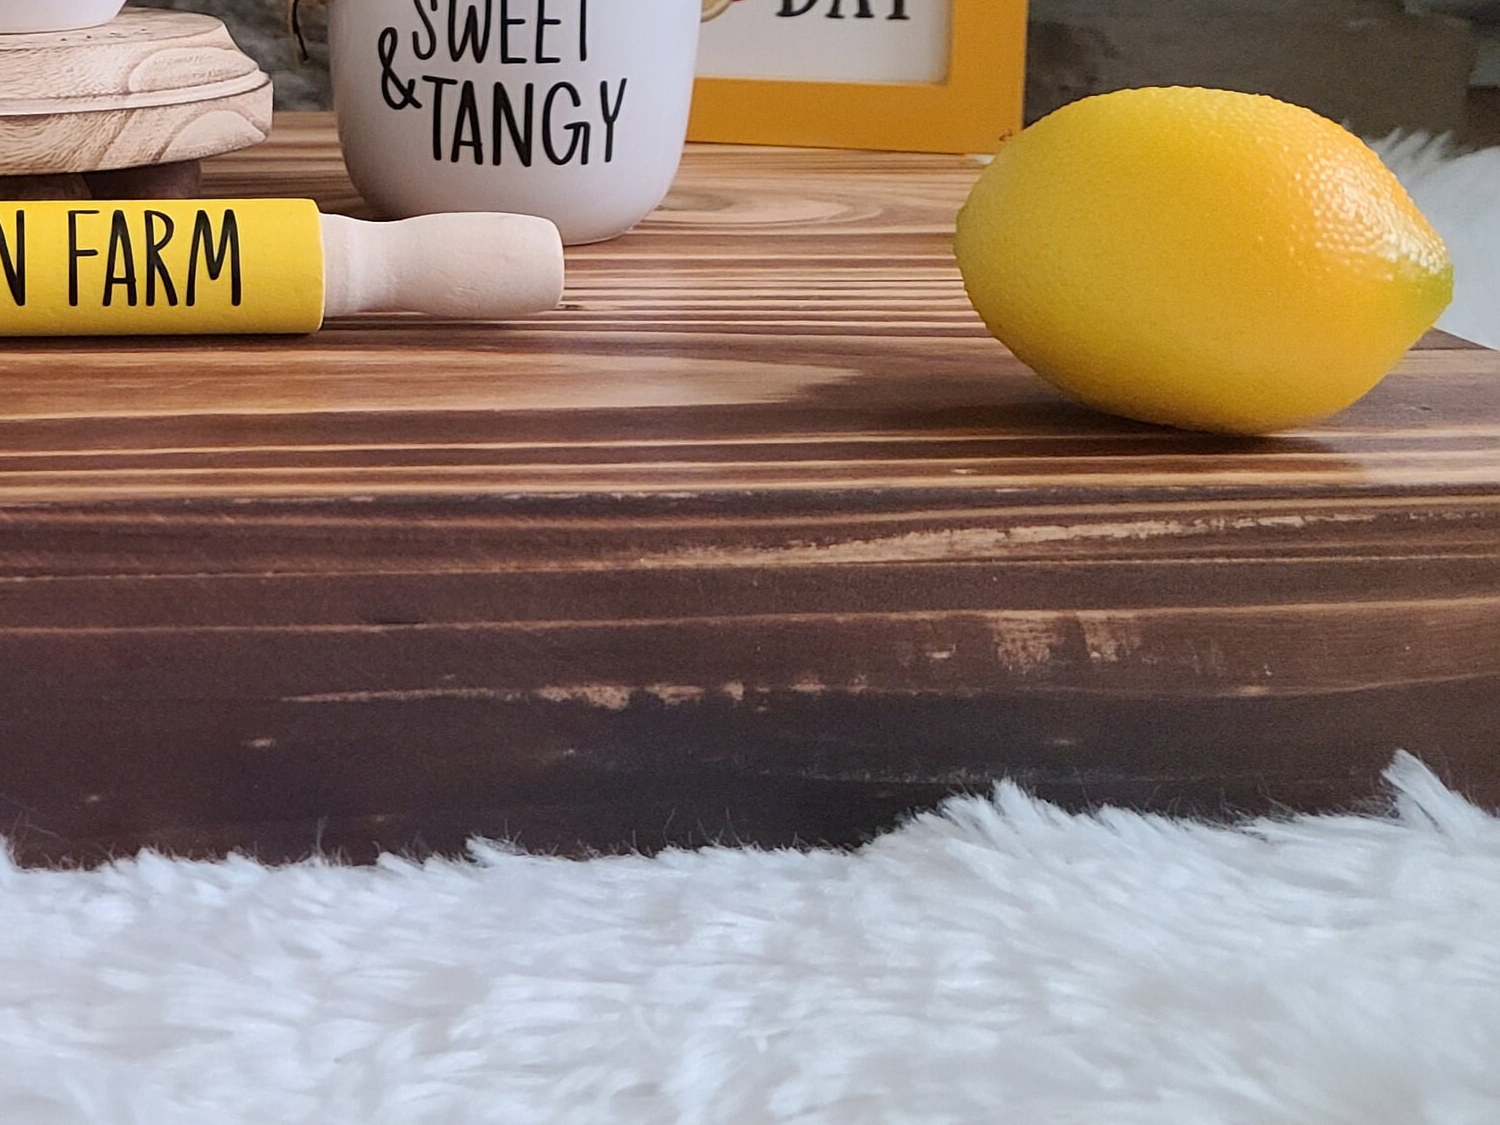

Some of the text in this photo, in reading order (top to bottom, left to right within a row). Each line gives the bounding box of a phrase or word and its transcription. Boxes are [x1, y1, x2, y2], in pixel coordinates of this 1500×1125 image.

[377, 26, 628, 168] & TANGY
[66, 208, 243, 308] FARM
